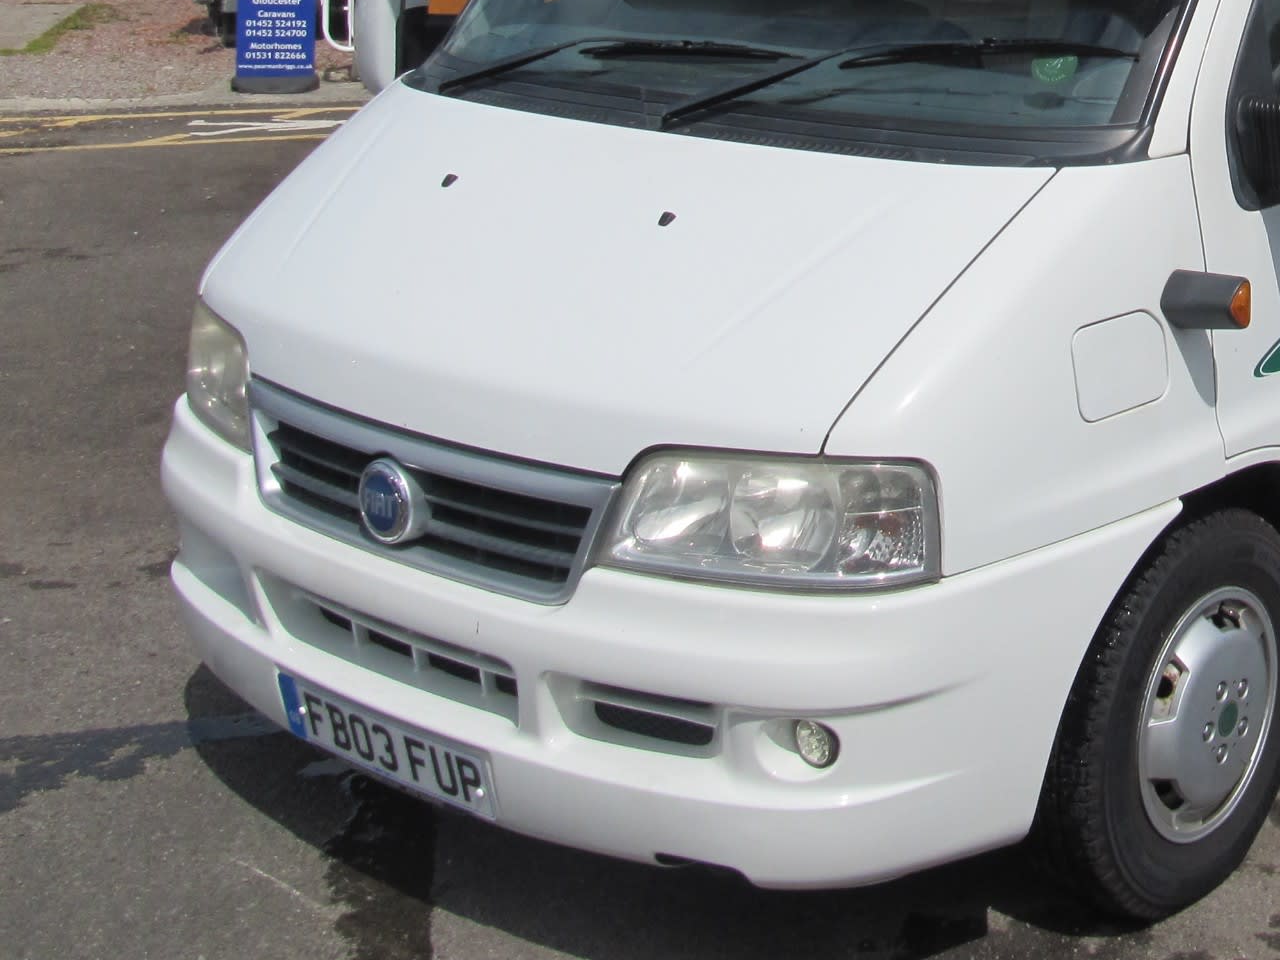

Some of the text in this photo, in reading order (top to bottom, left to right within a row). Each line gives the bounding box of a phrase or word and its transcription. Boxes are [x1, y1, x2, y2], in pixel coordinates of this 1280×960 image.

[258, 10, 295, 18] Caravans
[275, 20, 307, 28] 524192
[246, 29, 272, 37] 01452
[250, 42, 302, 50] Motorhomes
[275, 52, 306, 60] 822666
[303, 691, 482, 803] FB03 FUP
